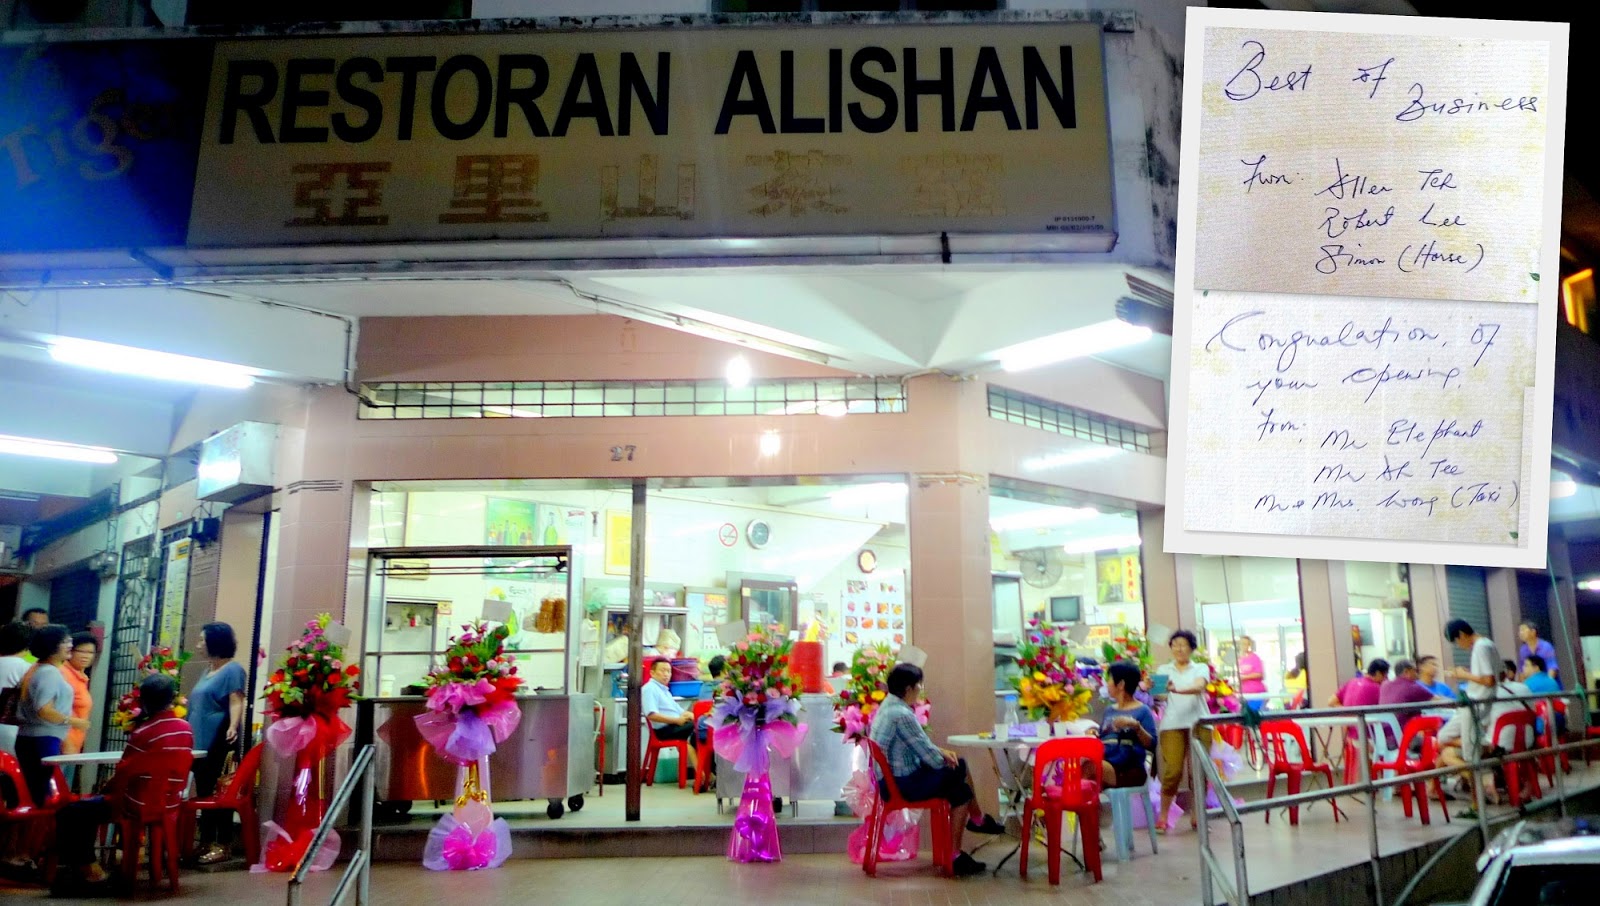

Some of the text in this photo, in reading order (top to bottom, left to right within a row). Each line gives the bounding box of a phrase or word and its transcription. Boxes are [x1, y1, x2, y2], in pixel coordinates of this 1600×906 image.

[1224, 40, 1396, 101] Best of
[219, 45, 1077, 144] RESTORAN ALISHAN
[1395, 82, 1539, 122] Business
[1314, 157, 1394, 200] Allen
[1317, 202, 1467, 238] Robert Lee
[1314, 243, 1386, 275] Simon
[1470, 323, 1501, 367] of
[1246, 377, 1319, 406] your
[610, 445, 636, 461] 27
[1320, 430, 1368, 450] Mr
[1387, 418, 1483, 460] Elephant
[1313, 463, 1367, 483] Mr
[1429, 459, 1465, 479] Tee
